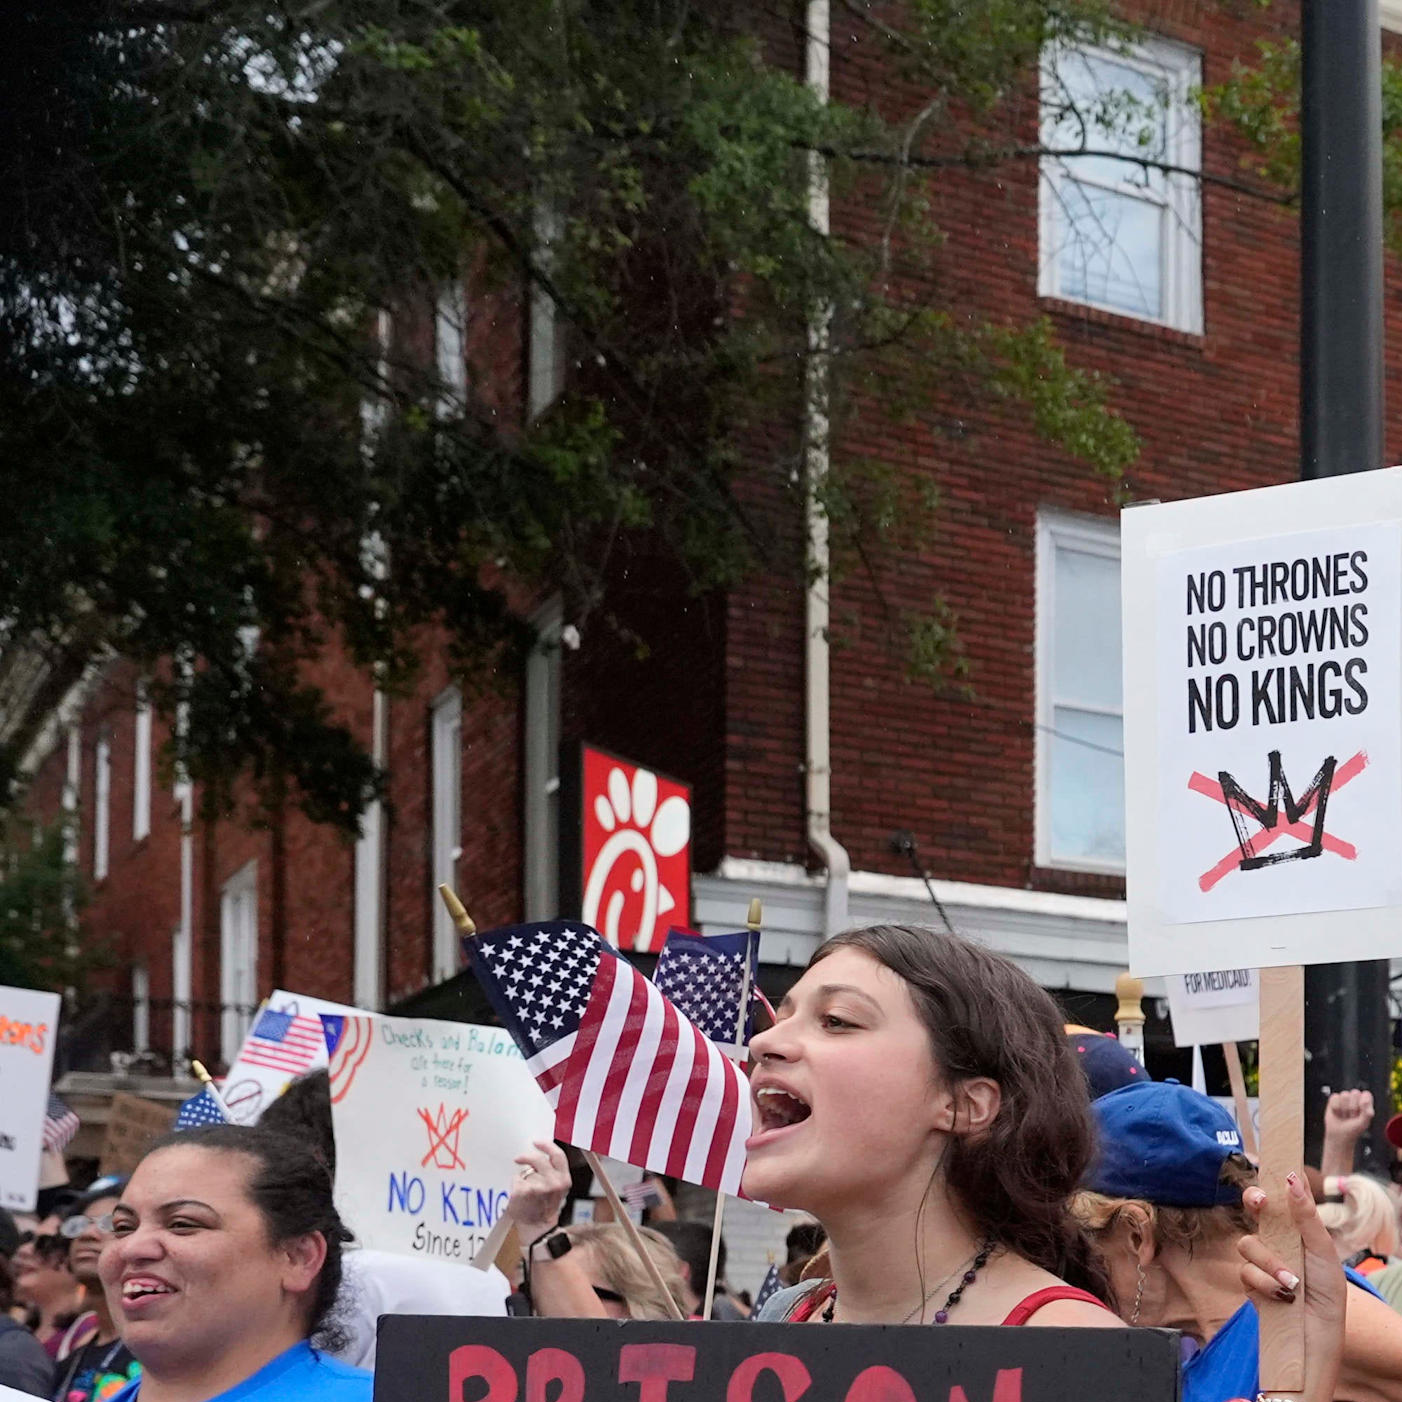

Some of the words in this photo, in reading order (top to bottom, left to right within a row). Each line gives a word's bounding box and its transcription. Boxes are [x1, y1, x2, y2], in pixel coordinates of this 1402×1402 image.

[1187, 569, 1228, 616] NO
[1233, 550, 1368, 610] THRONES
[1187, 621, 1228, 668] NO
[1236, 602, 1369, 662] CROWNS
[1188, 673, 1240, 734] NO
[1252, 657, 1369, 727] KINGS
[388, 1172, 425, 1215] NO
[412, 1222, 461, 1258] Since
